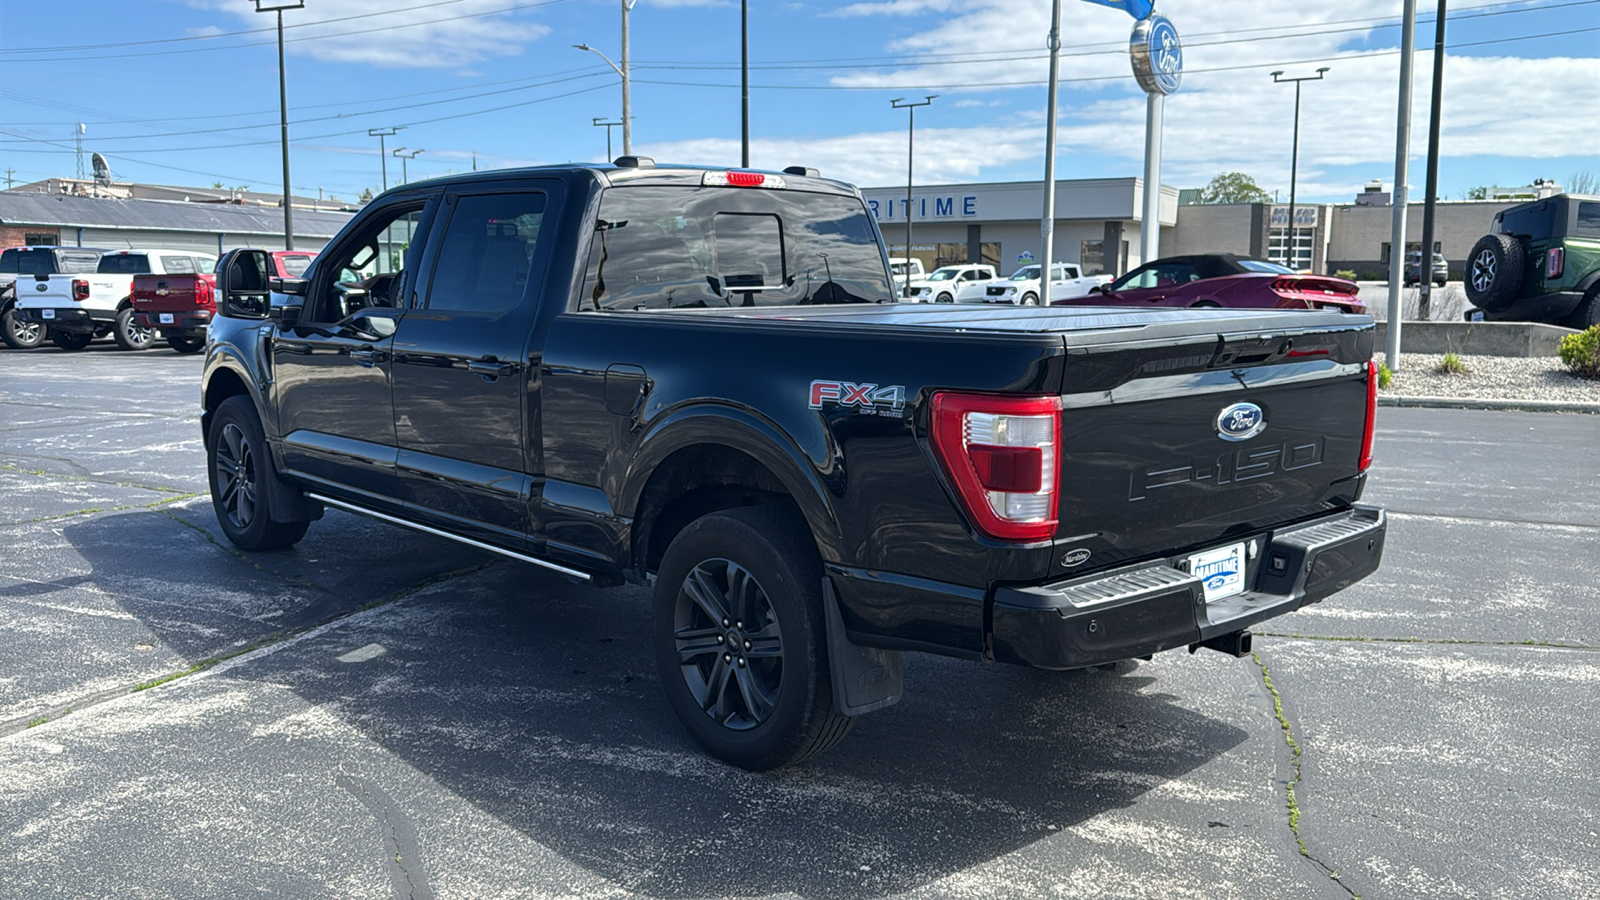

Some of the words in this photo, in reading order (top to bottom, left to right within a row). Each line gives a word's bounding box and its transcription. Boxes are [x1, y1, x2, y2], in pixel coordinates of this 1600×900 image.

[1159, 30, 1181, 80] Ford
[808, 379, 905, 412] FX4
[879, 410, 903, 418] ROAD
[1230, 410, 1255, 430] Ford
[1128, 435, 1326, 502] F-150
[1194, 556, 1239, 580] MARITIME
